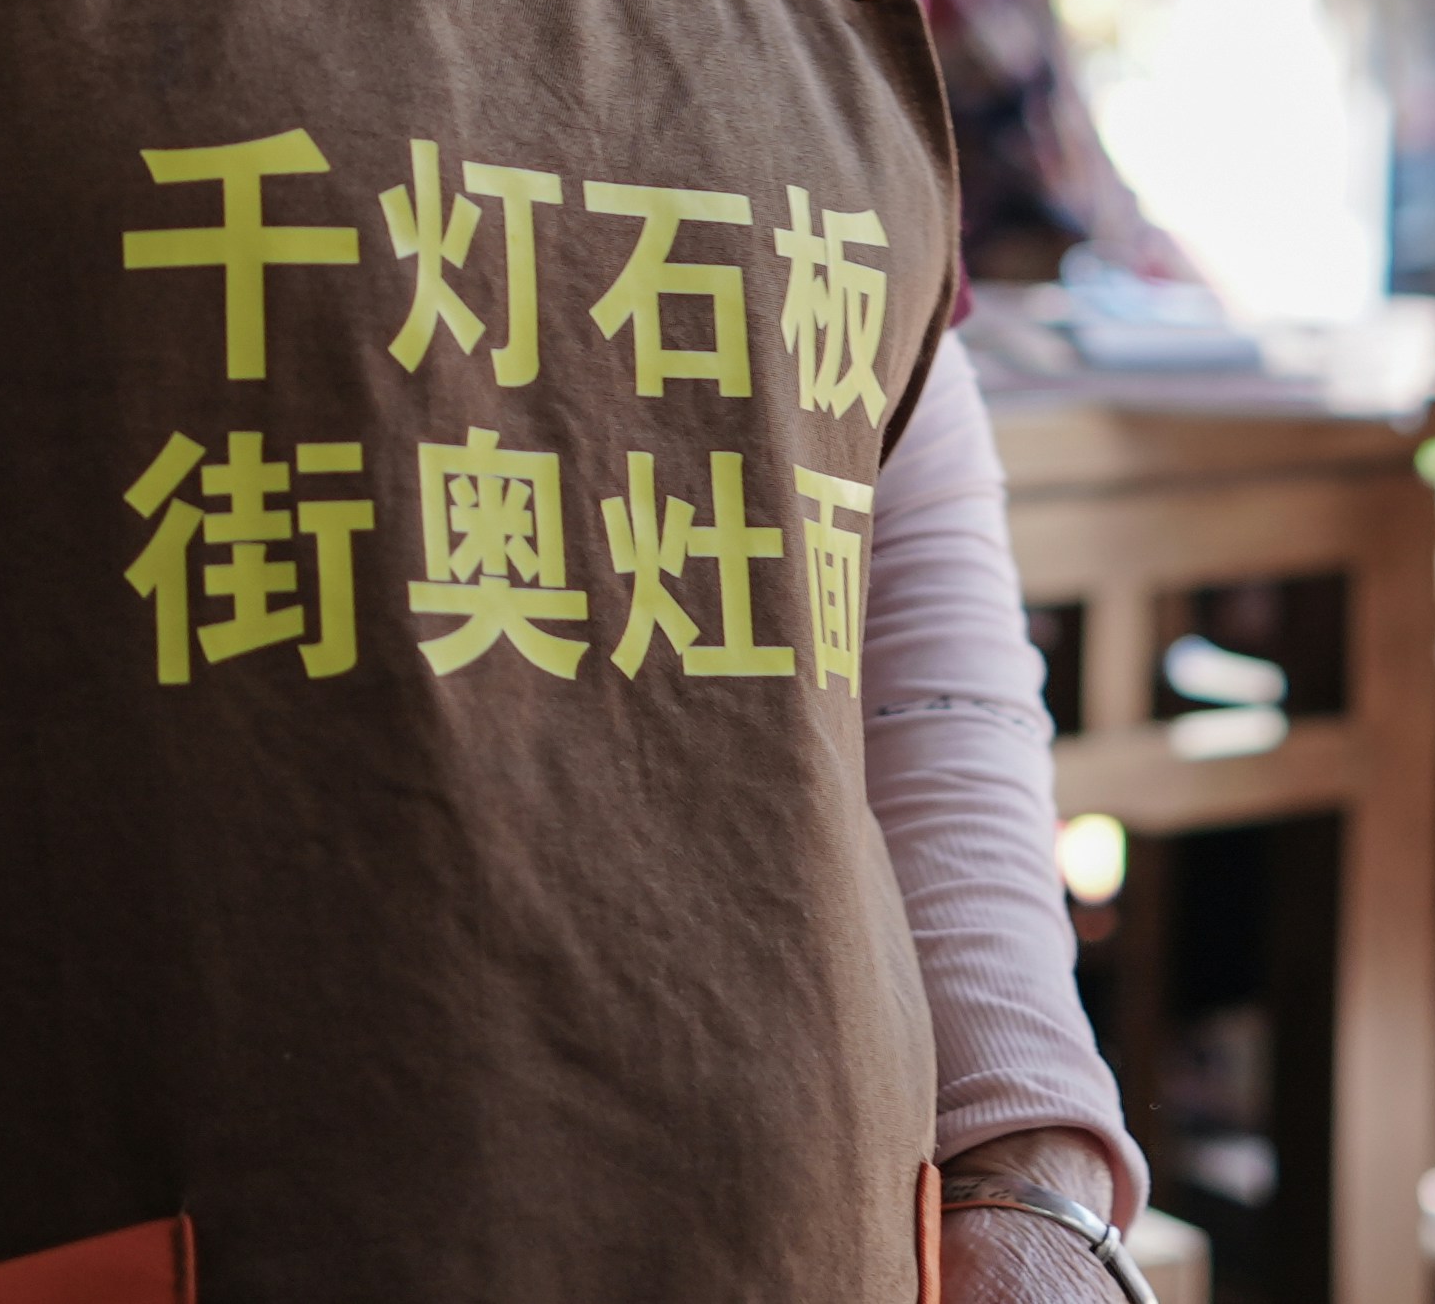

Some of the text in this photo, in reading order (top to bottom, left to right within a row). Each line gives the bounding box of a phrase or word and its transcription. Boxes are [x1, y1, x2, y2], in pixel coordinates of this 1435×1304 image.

[122, 128, 890, 429] 千灯石板
[122, 426, 874, 699] 街奥灶面
